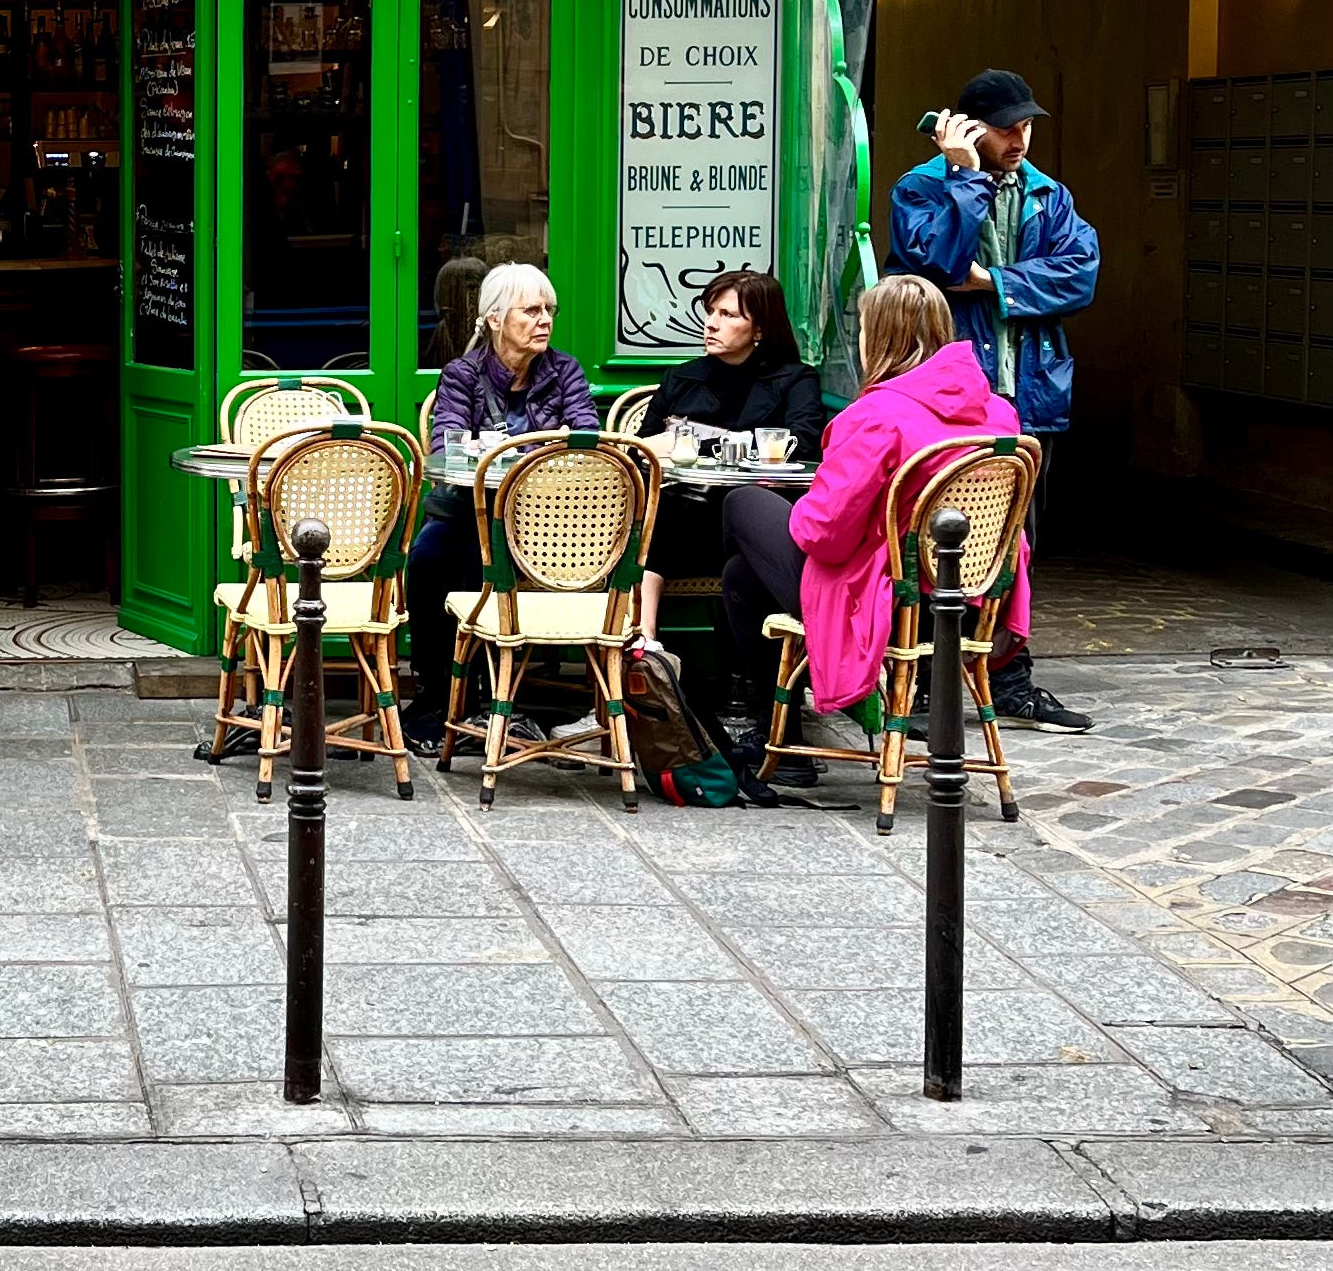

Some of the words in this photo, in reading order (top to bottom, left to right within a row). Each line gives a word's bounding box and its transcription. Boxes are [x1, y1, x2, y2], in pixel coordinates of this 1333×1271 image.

[639, 46, 671, 67] DE
[685, 45, 759, 67] CHOIX
[628, 101, 765, 140] BIERE
[627, 165, 682, 191] BRUNE
[689, 169, 704, 192] &
[709, 165, 768, 191] BLONDE
[630, 226, 762, 249] TELEPHONE
